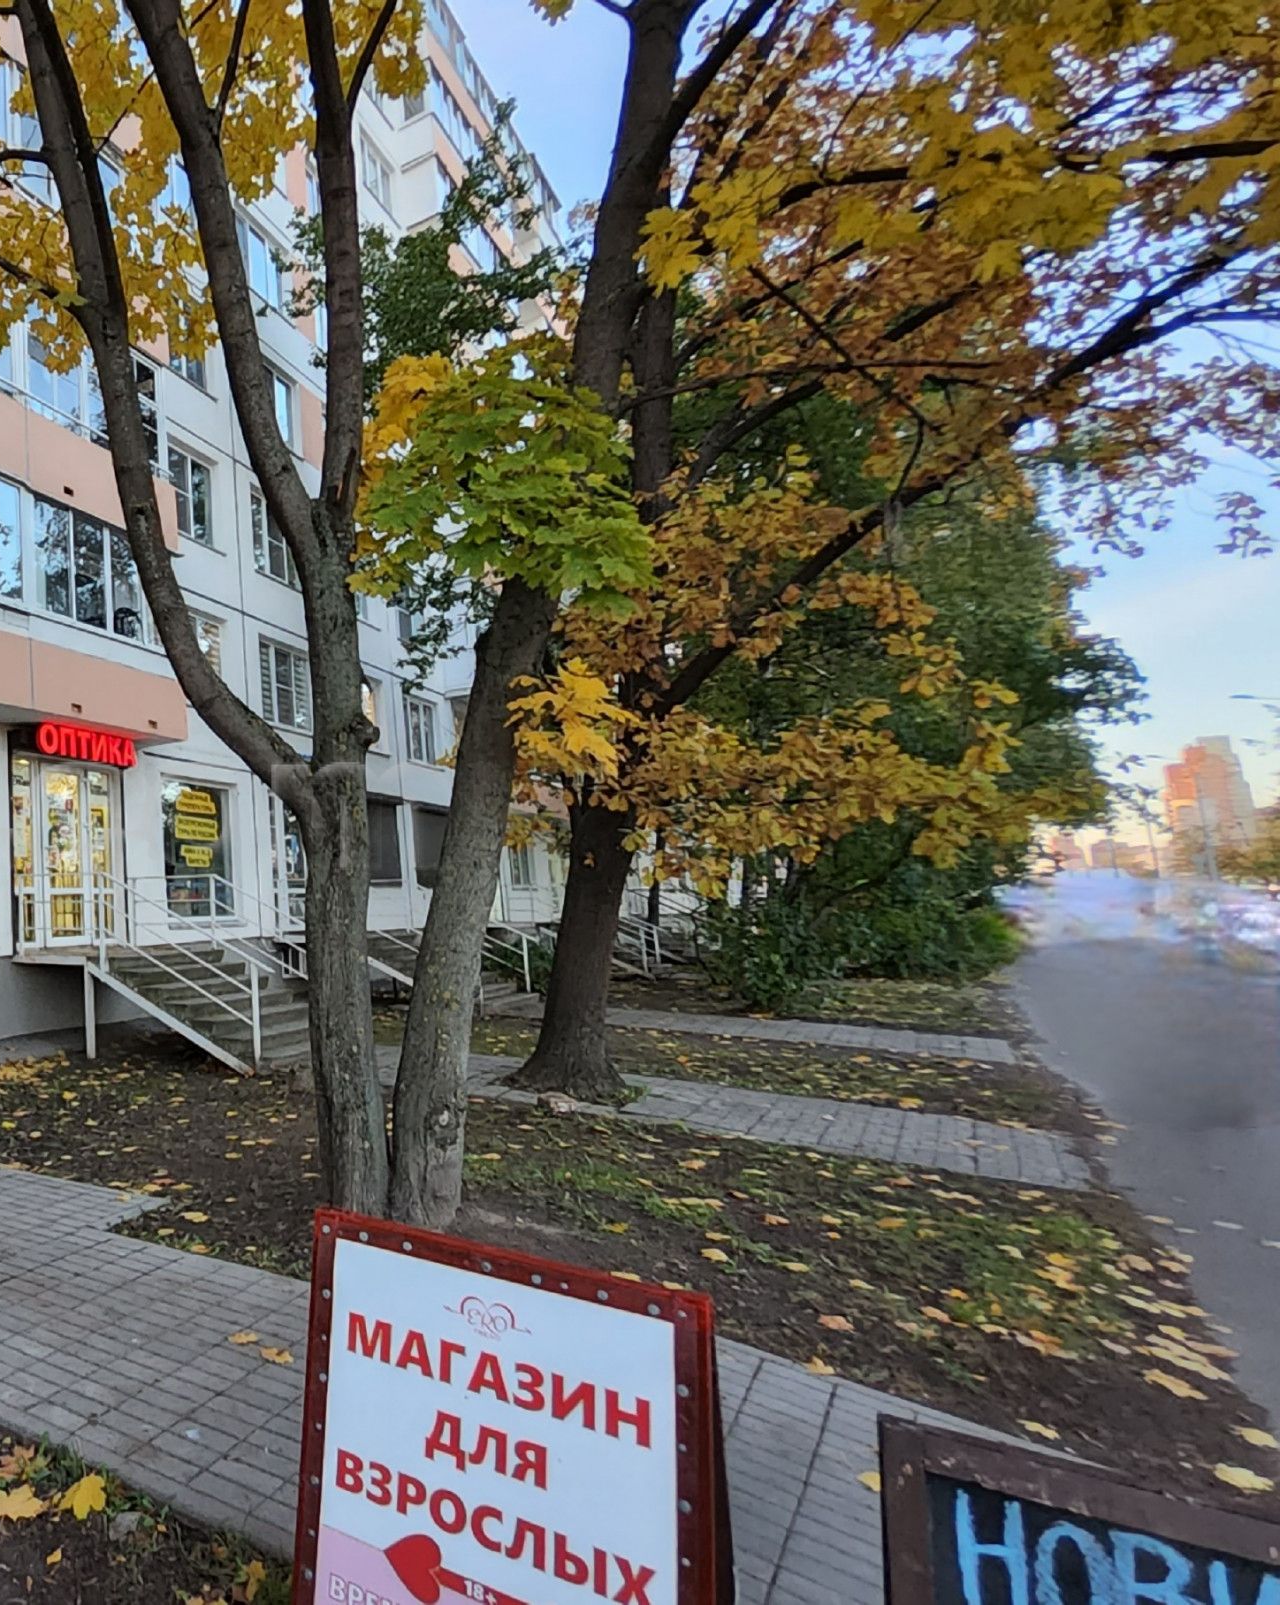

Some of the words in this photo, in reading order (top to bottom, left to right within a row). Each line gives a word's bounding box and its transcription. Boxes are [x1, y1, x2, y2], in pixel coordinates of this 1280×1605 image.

[38, 723, 137, 768] ОПТИКА
[346, 1311, 652, 1449] МАГАЗИН
[424, 1410, 549, 1491] ДЛЯ
[334, 1447, 657, 1605] ВЗРОСЛЫХ
[463, 1579, 498, 1605] 18+
